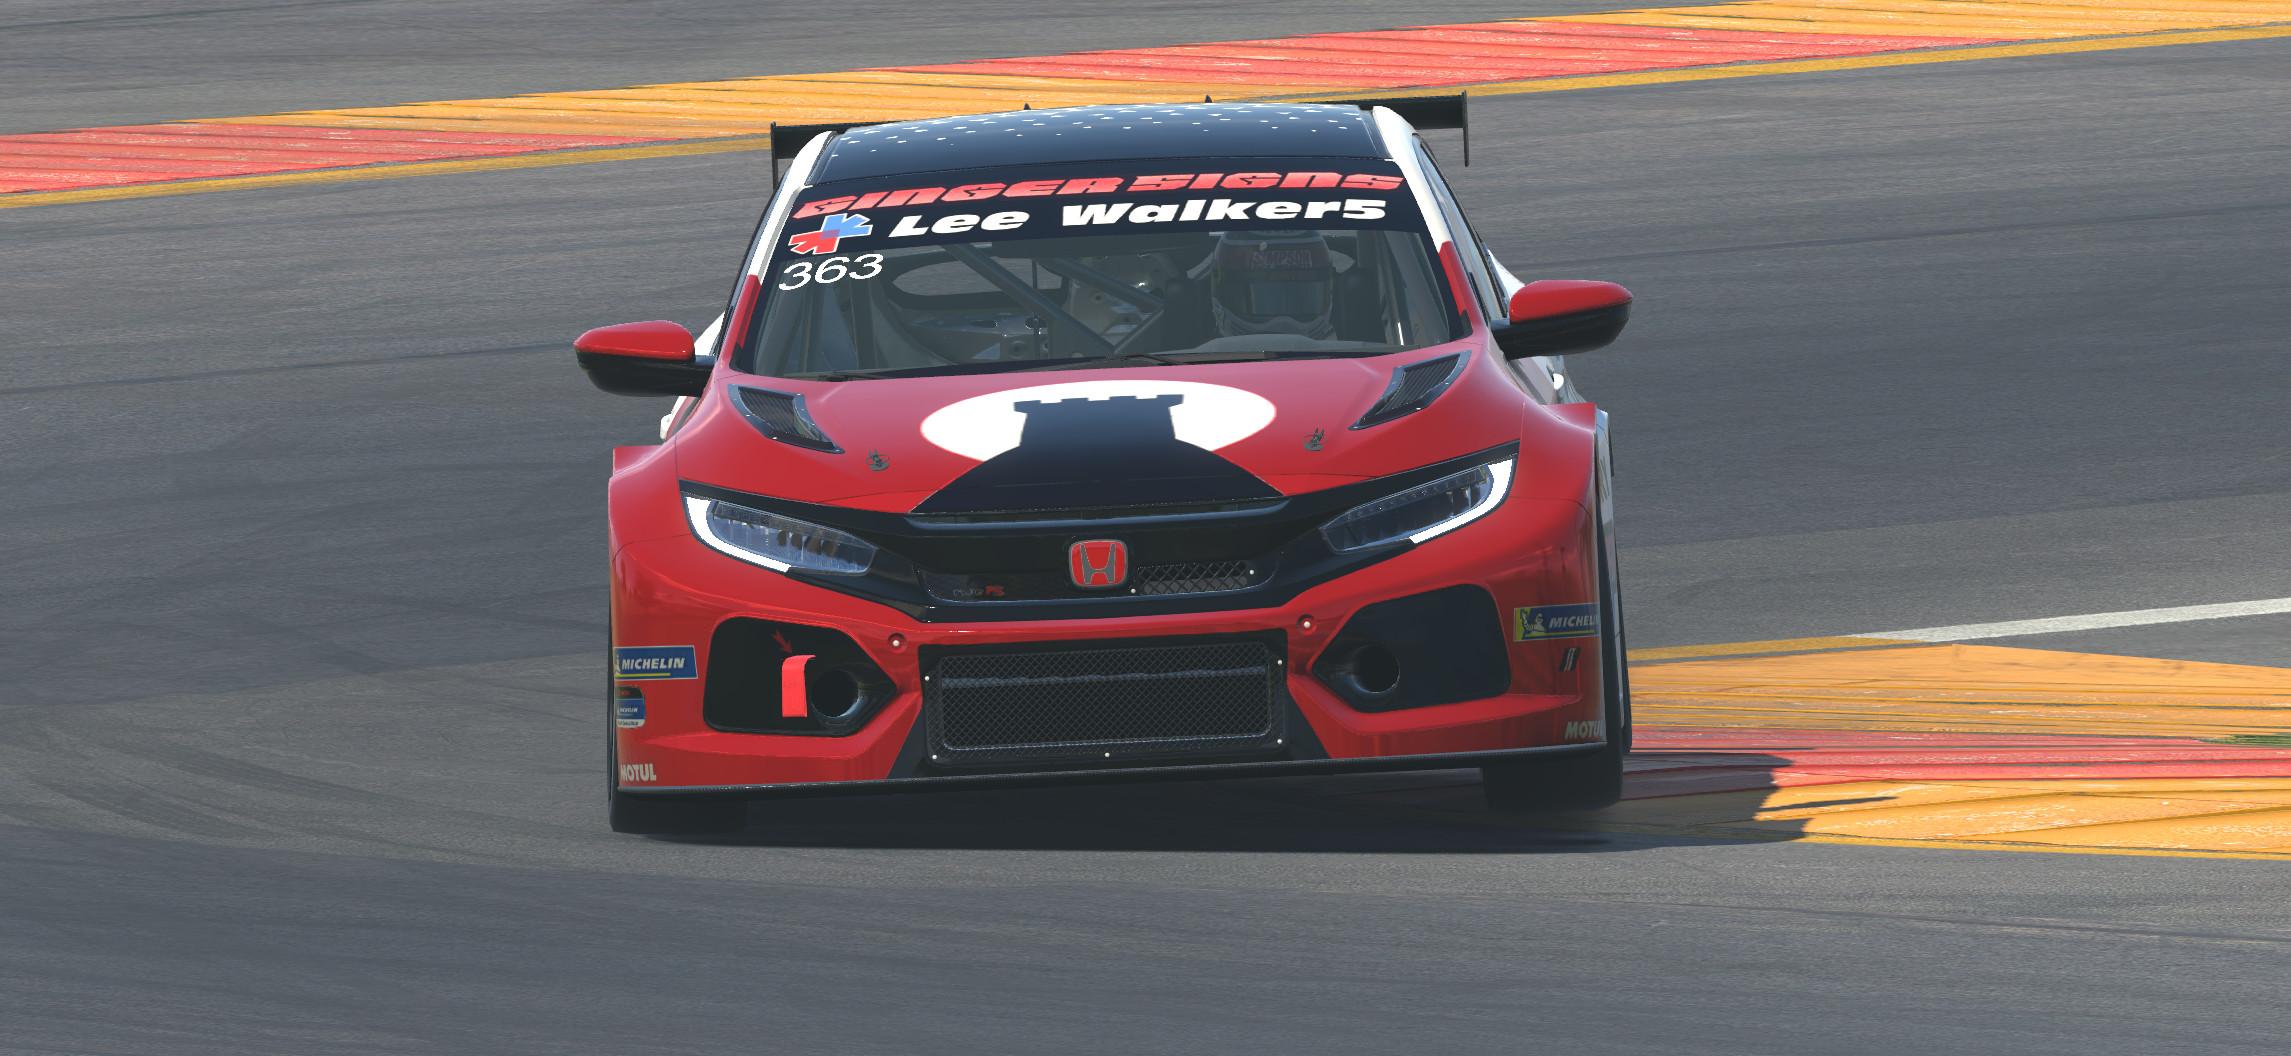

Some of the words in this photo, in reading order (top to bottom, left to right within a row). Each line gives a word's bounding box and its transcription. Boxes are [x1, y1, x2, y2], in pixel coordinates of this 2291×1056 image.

[792, 177, 1125, 219] GINGER
[1127, 171, 1406, 191] SIGNS
[888, 210, 1031, 238] Lee
[1062, 199, 1387, 227] Walker5
[778, 253, 884, 291] 363
[621, 656, 686, 670] MICHELIN
[620, 763, 656, 781] MOTUL
